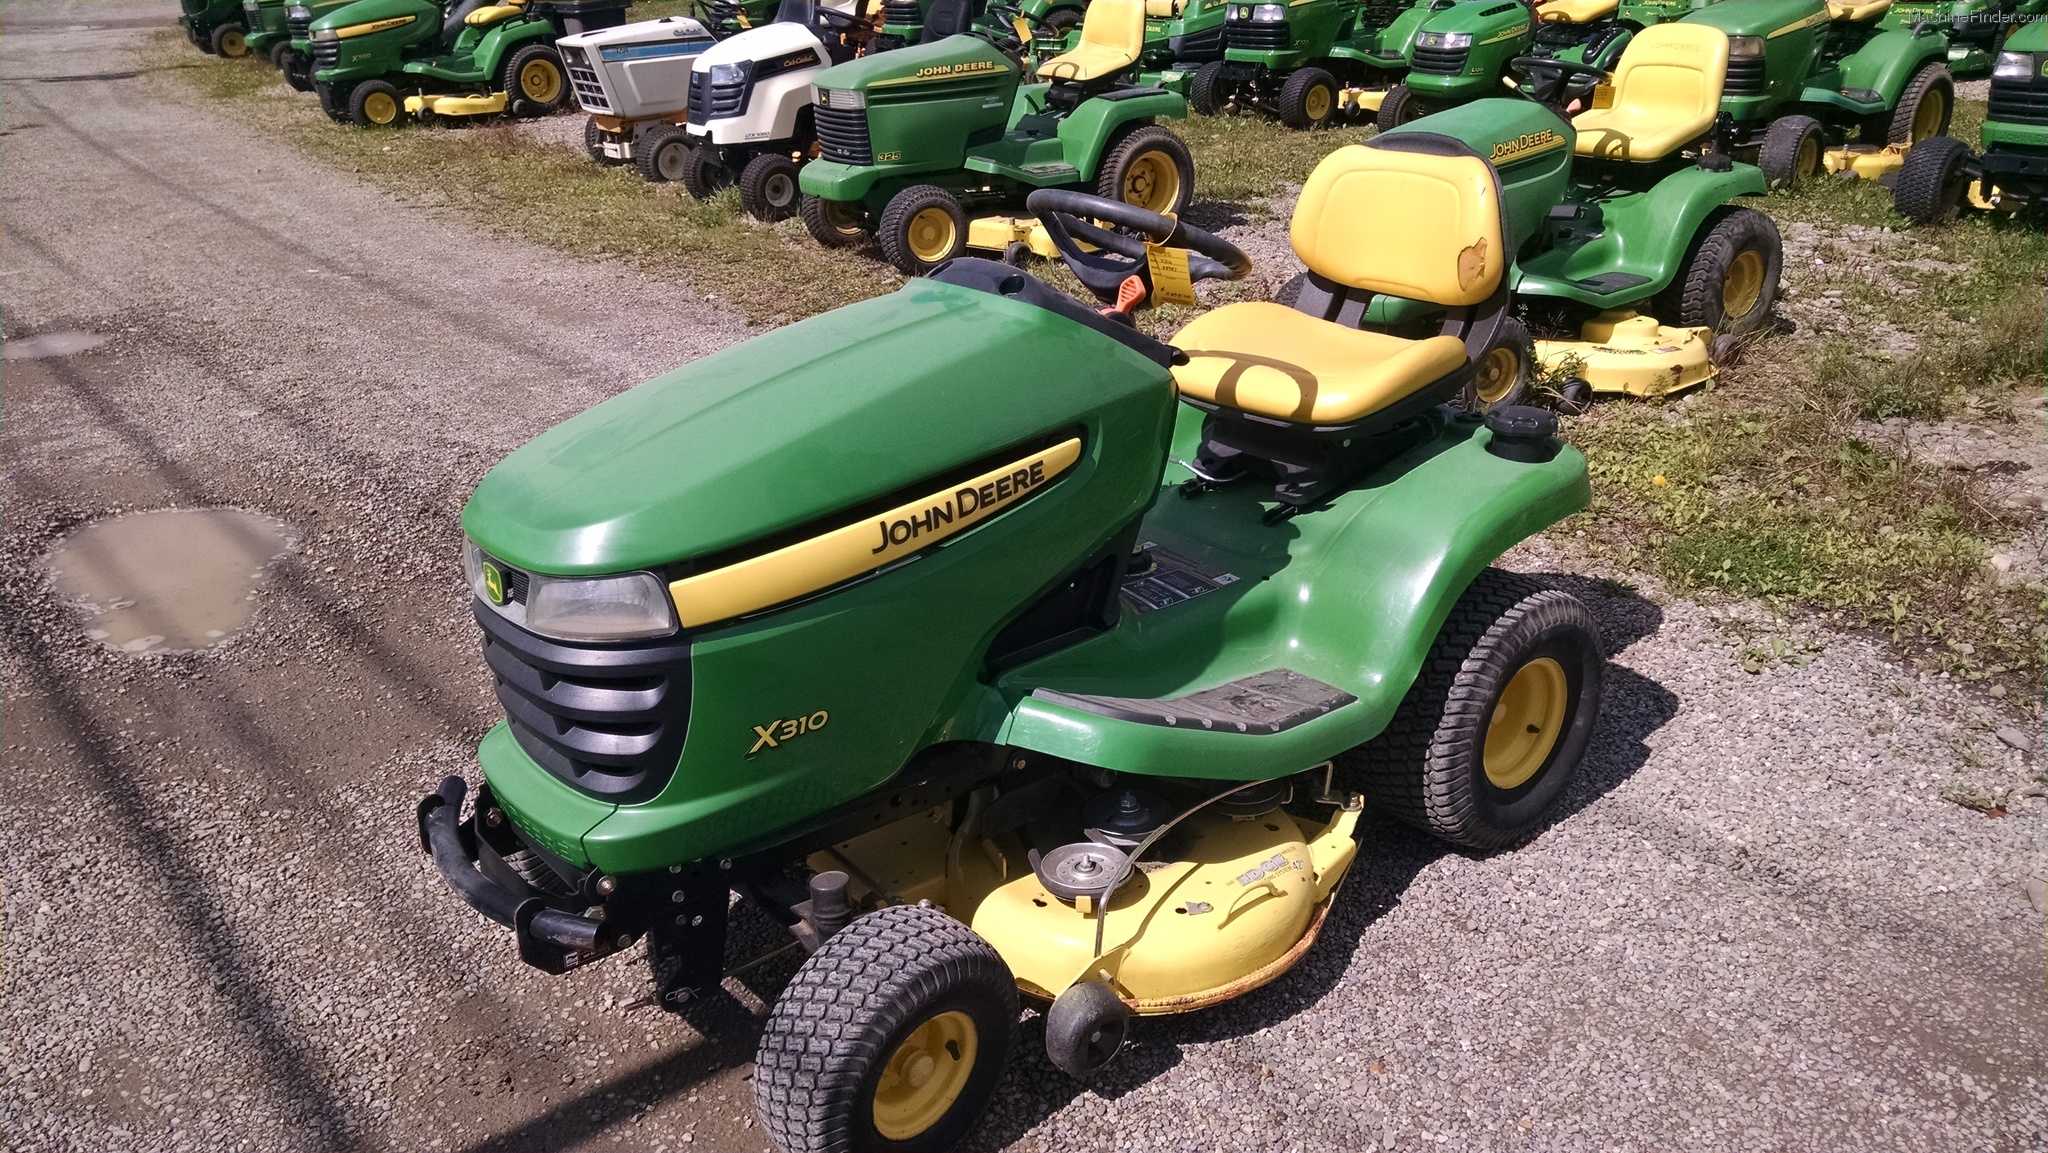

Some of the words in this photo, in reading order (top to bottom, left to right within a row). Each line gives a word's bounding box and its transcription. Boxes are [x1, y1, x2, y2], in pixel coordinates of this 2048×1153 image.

[916, 64, 952, 78] JOHN
[954, 61, 995, 74] DEERE
[877, 152, 901, 161] 325
[1489, 138, 1520, 159] JOHN
[1519, 128, 1553, 151] DEERE
[872, 501, 954, 555] JOHN
[955, 460, 1046, 520] DEERE
[747, 710, 829, 756] X310
[1236, 853, 1289, 887] EDGE
